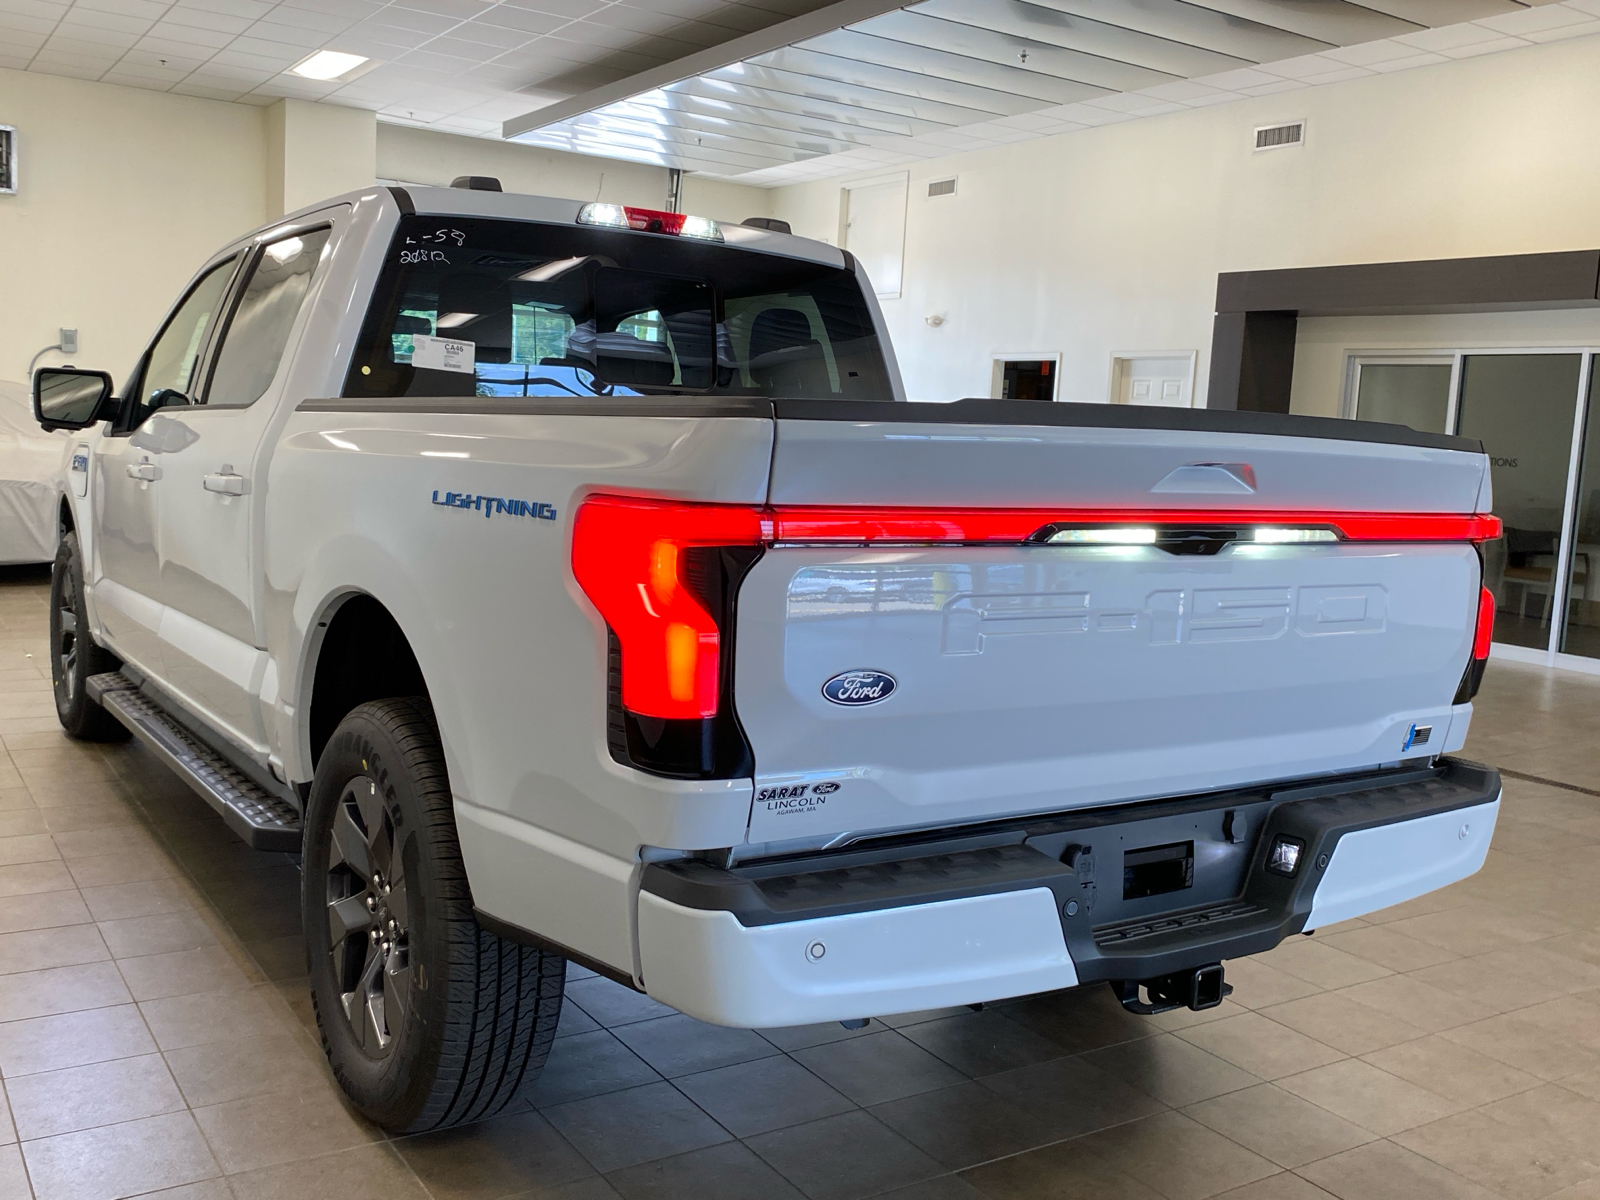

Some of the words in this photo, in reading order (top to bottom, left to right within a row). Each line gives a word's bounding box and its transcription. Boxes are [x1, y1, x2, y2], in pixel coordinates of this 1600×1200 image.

[444, 343, 465, 353] CA46
[432, 490, 557, 520] LIGHTNING
[942, 583, 1390, 656] F-150
[757, 784, 809, 801] SARAT
[767, 796, 826, 810] LINCOLN
[776, 807, 805, 816] AGAWAM,
